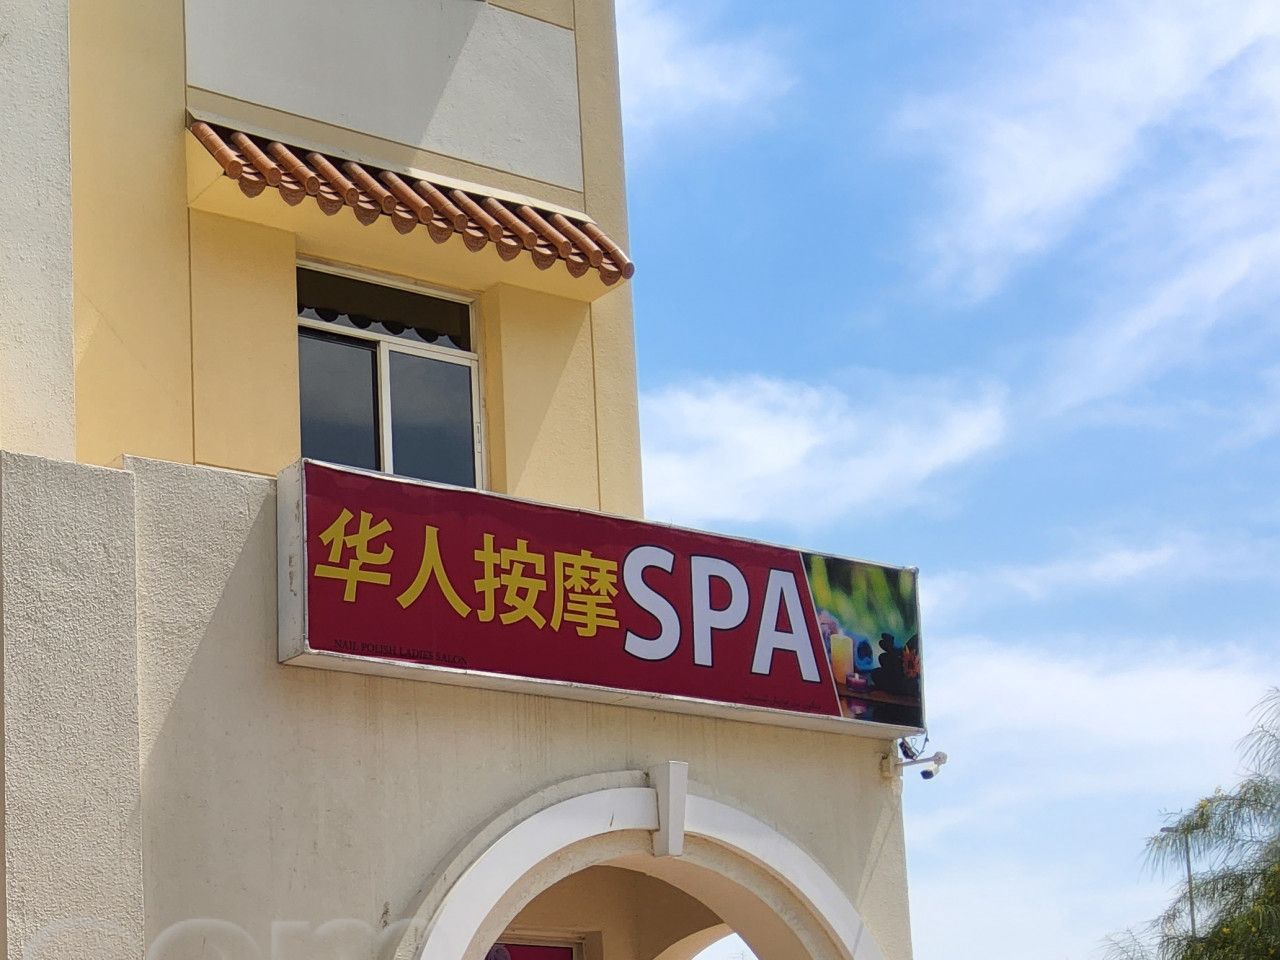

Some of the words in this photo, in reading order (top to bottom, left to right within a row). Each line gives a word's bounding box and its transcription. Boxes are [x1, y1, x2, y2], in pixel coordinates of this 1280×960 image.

[314, 507, 620, 637] 华人按摩
[622, 545, 821, 683] SPA
[334, 639, 357, 651] NAIL
[361, 642, 396, 656] POLISH
[399, 647, 433, 659] LADIES
[436, 651, 467, 664] SALON
